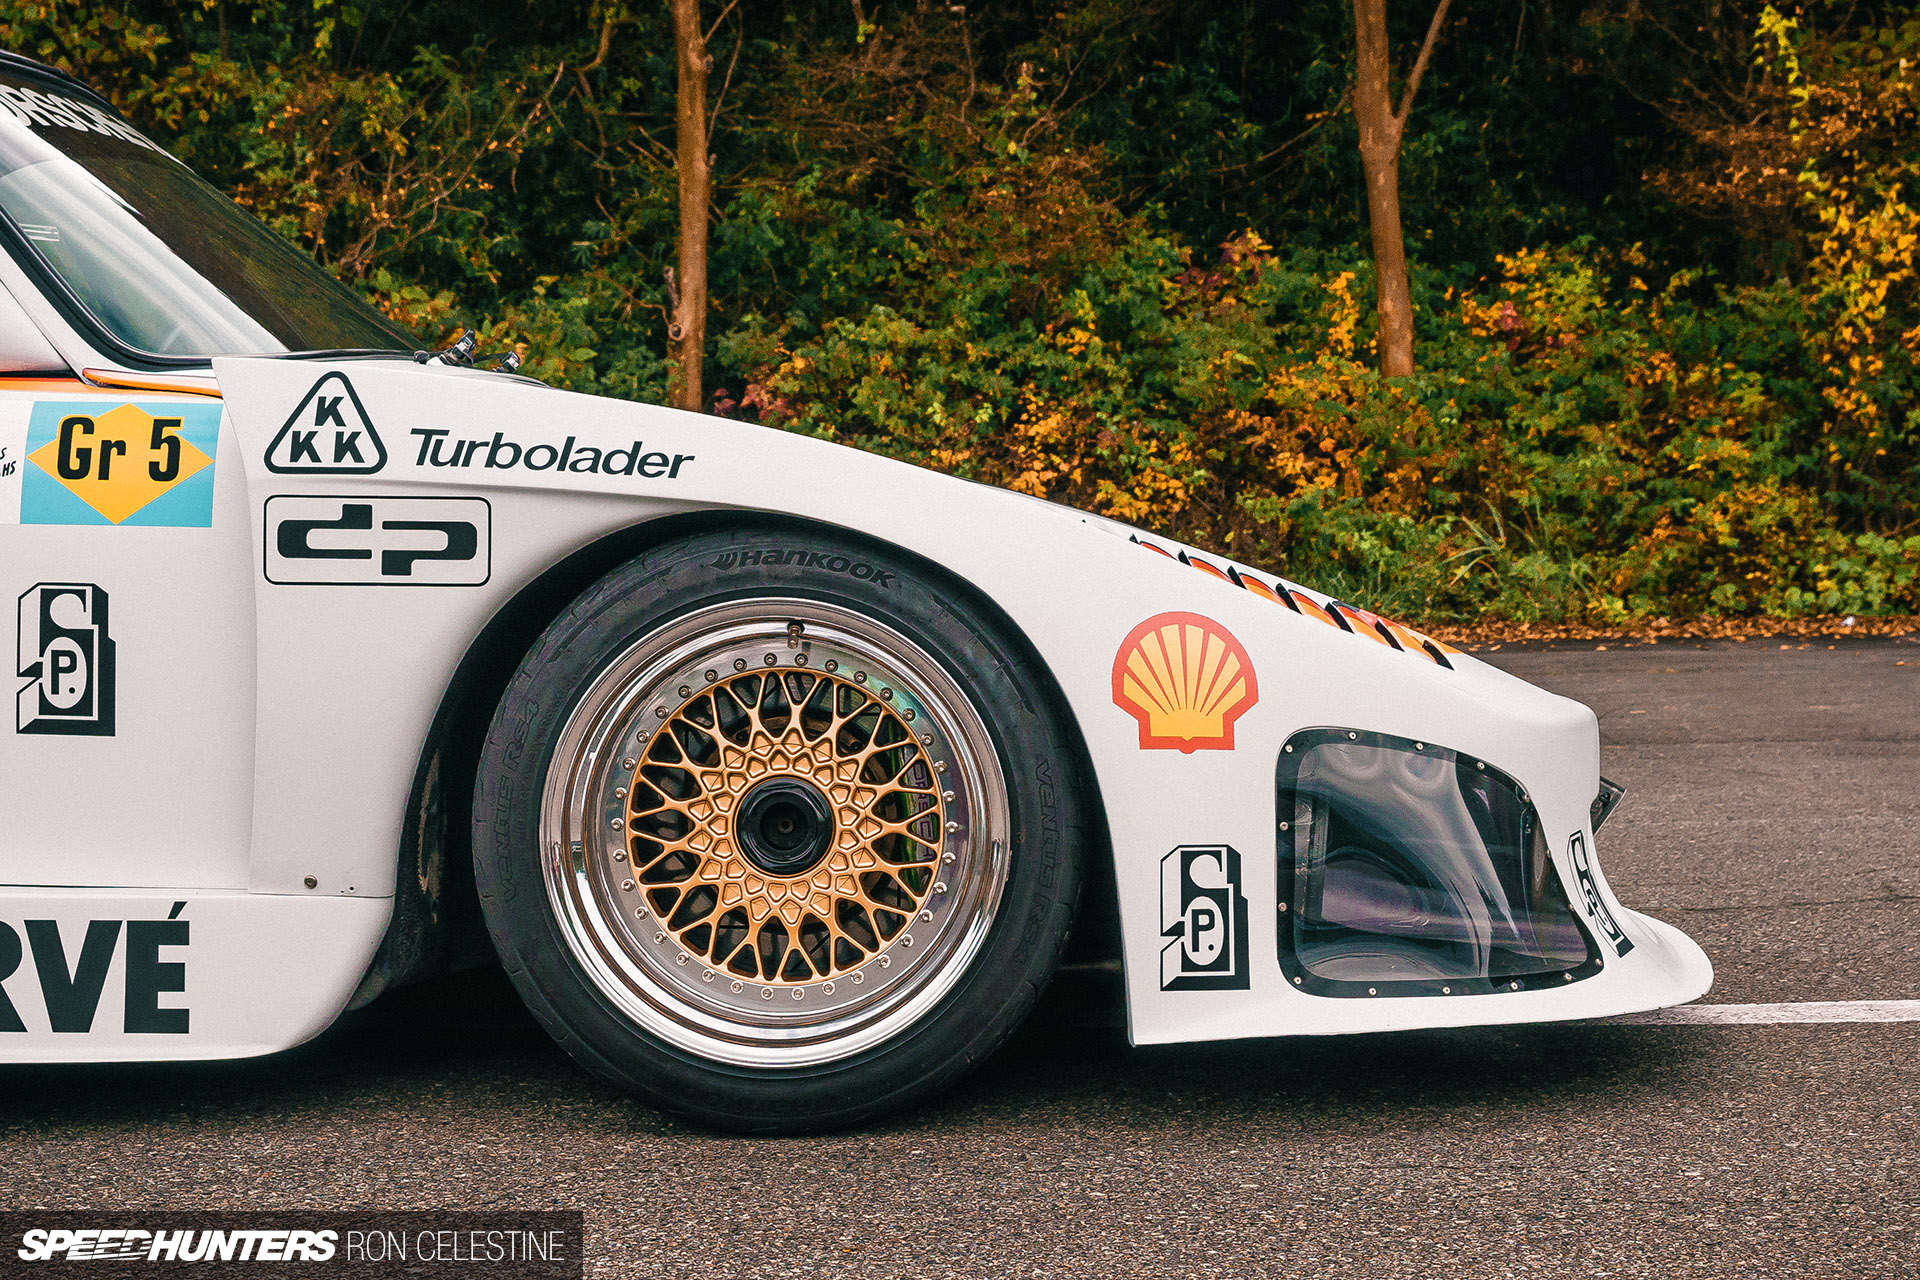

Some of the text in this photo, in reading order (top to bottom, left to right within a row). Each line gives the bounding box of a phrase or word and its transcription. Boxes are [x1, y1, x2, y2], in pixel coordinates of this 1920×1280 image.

[314, 396, 345, 427] K
[57, 416, 182, 483] Gr 5
[410, 427, 696, 479] Turbolader
